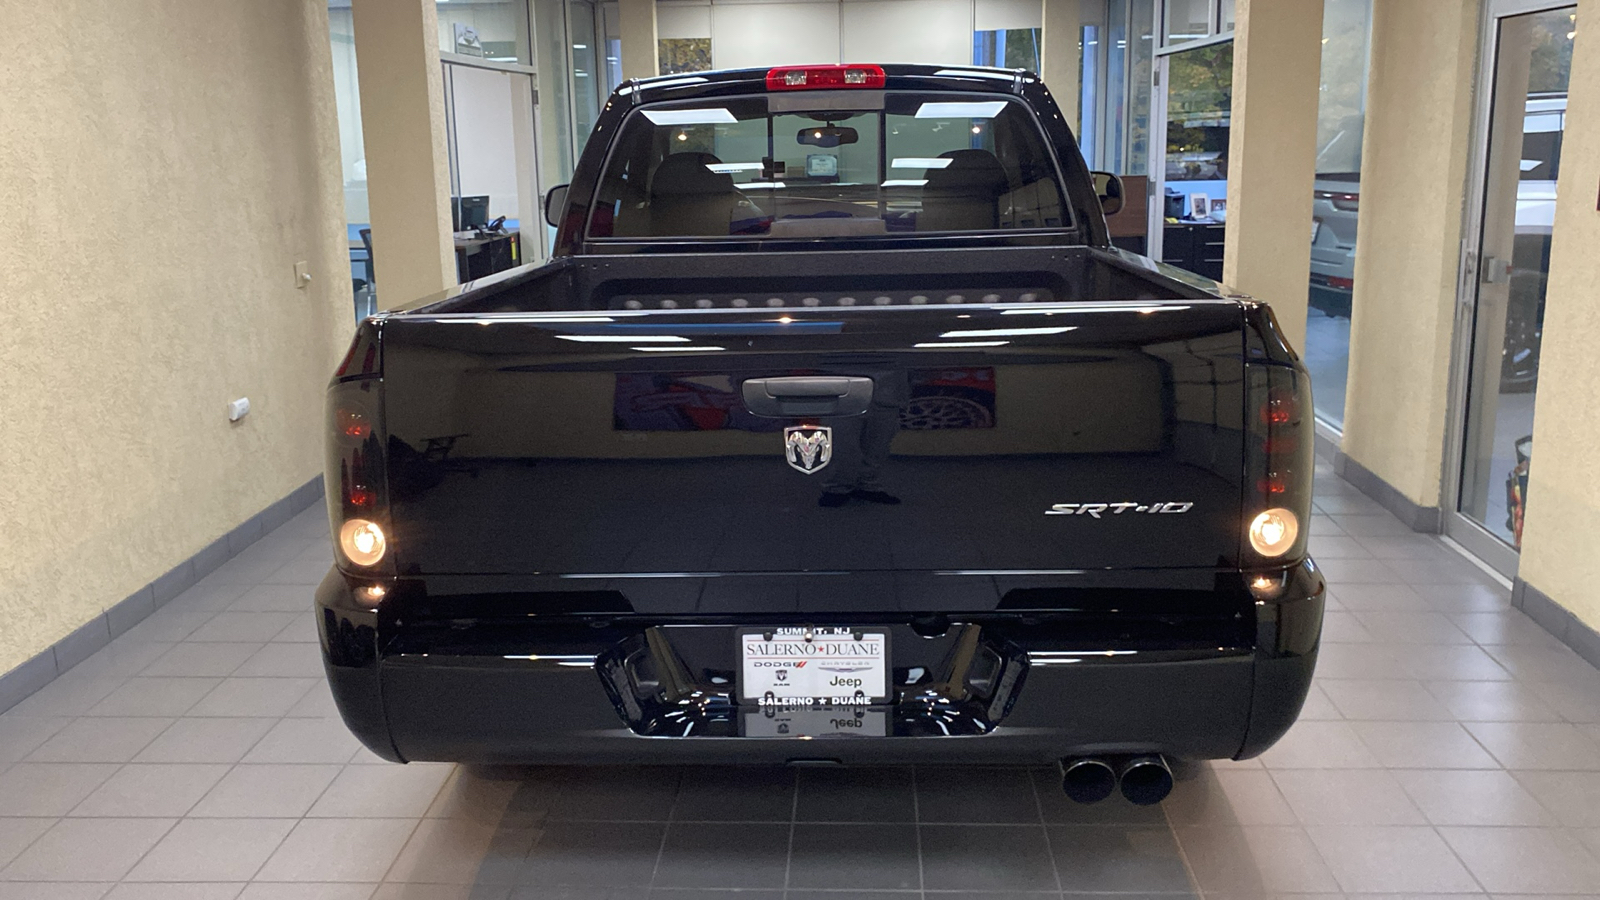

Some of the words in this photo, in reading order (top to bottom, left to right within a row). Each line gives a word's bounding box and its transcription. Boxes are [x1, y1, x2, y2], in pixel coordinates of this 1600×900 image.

[834, 627, 850, 635] NJ
[746, 644, 816, 656] SALERNO
[826, 644, 880, 656] DUANE
[829, 676, 862, 688] Jeep
[758, 696, 814, 706] SALERNO
[831, 697, 872, 705] DUANE
